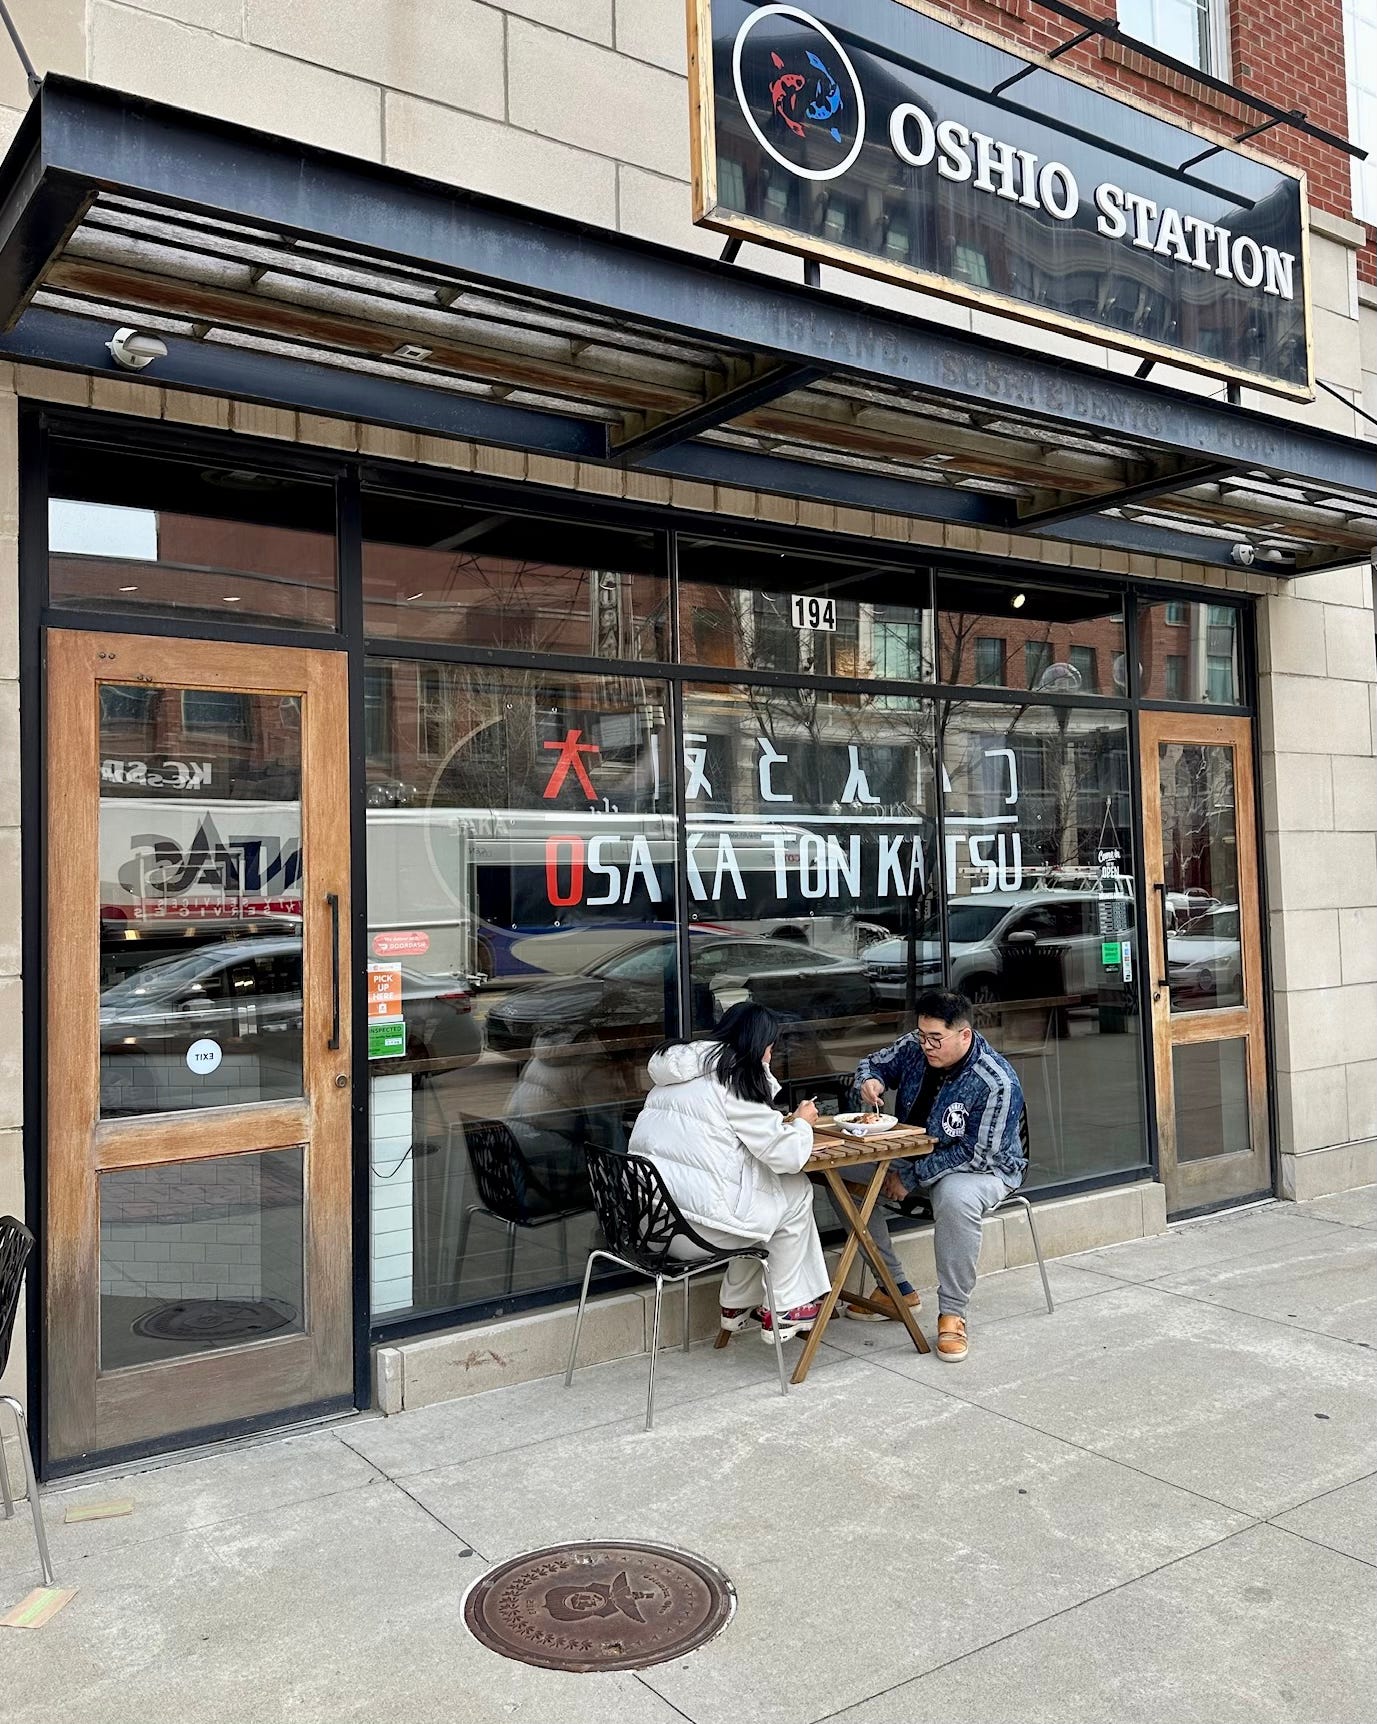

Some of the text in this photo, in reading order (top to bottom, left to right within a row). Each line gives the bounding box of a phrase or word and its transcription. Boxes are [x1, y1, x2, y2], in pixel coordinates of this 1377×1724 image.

[889, 102, 1295, 301] OSHIO STATION
[795, 597, 836, 630] 194
[545, 833, 747, 907] OSAKA
[1102, 866, 1120, 879] OPEN
[373, 974, 393, 983] PICK
[377, 984, 389, 992] UP
[372, 992, 394, 1001] HERE
